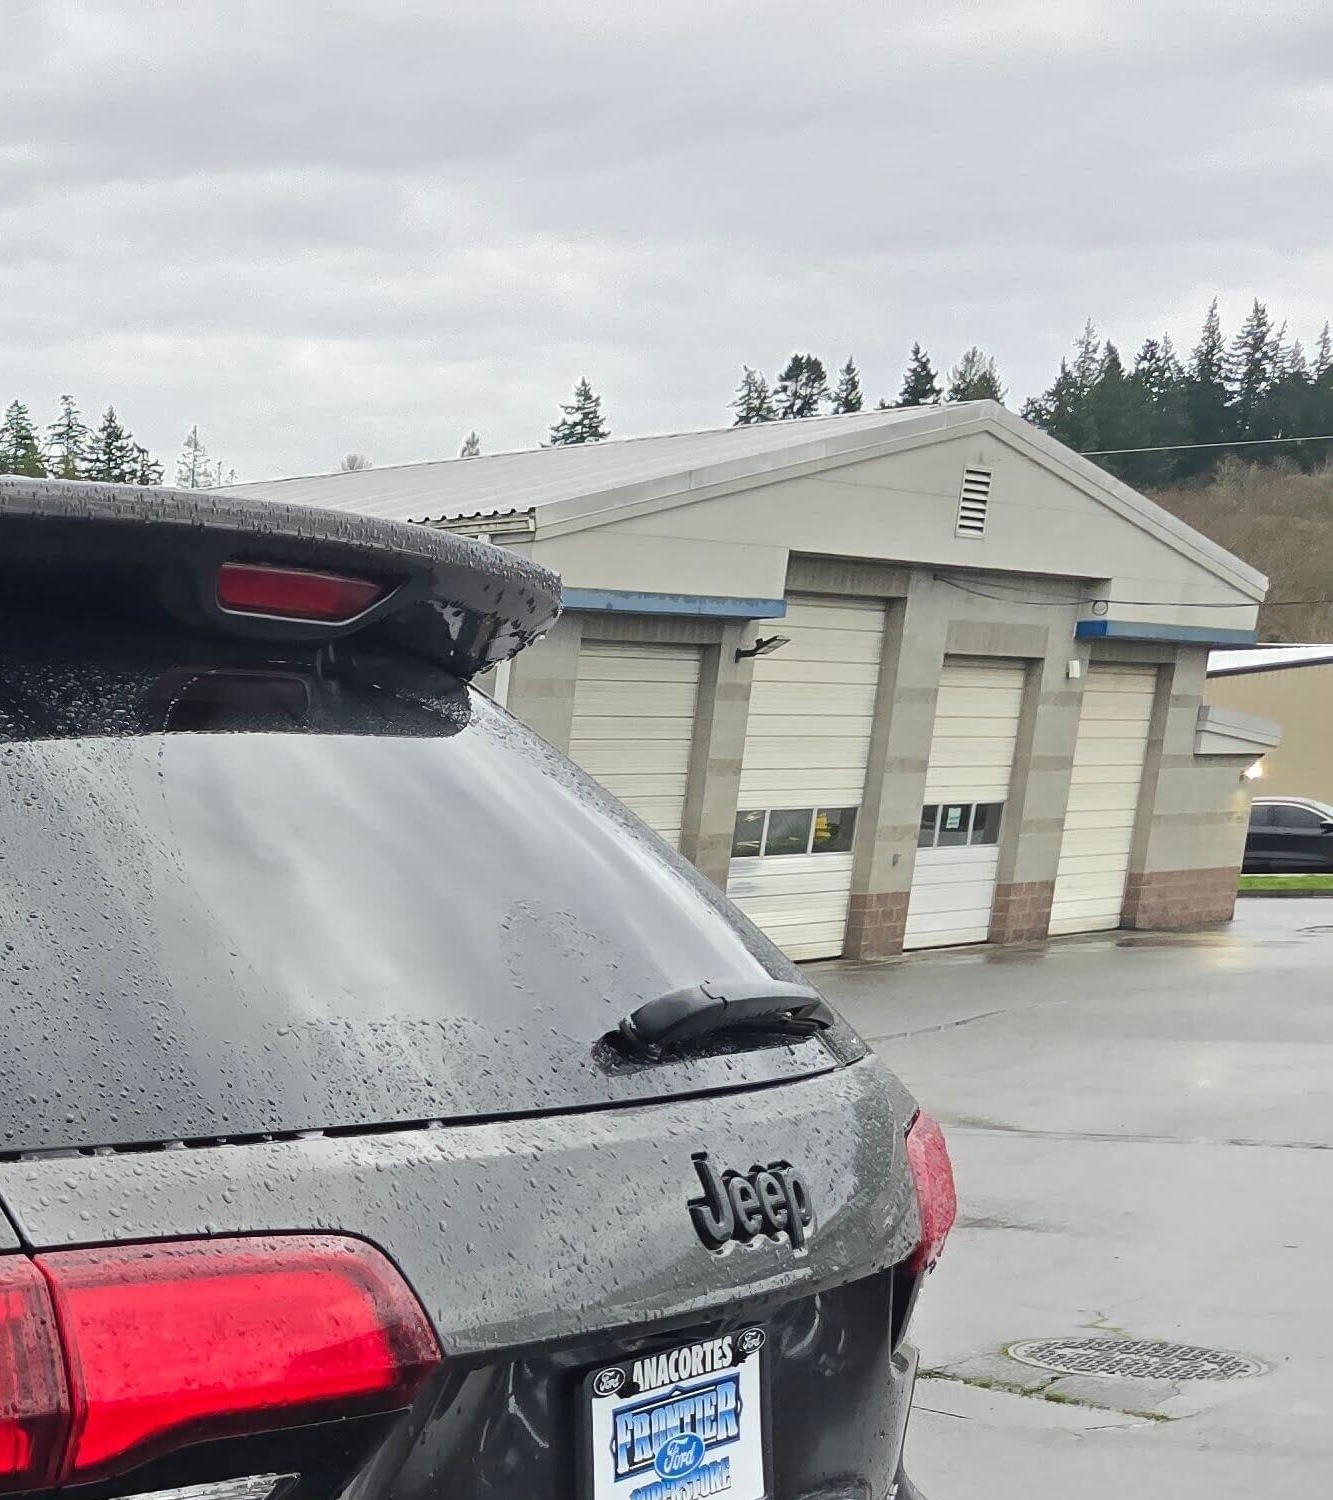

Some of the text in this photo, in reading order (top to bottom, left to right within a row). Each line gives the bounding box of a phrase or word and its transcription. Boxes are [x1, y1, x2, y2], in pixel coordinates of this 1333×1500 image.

[687, 1151, 813, 1251] Jeep
[598, 1370, 622, 1392] Ford
[633, 1335, 733, 1392] ANACORTES
[616, 1381, 739, 1475] FRONTIER
[664, 1437, 697, 1474] Ford
